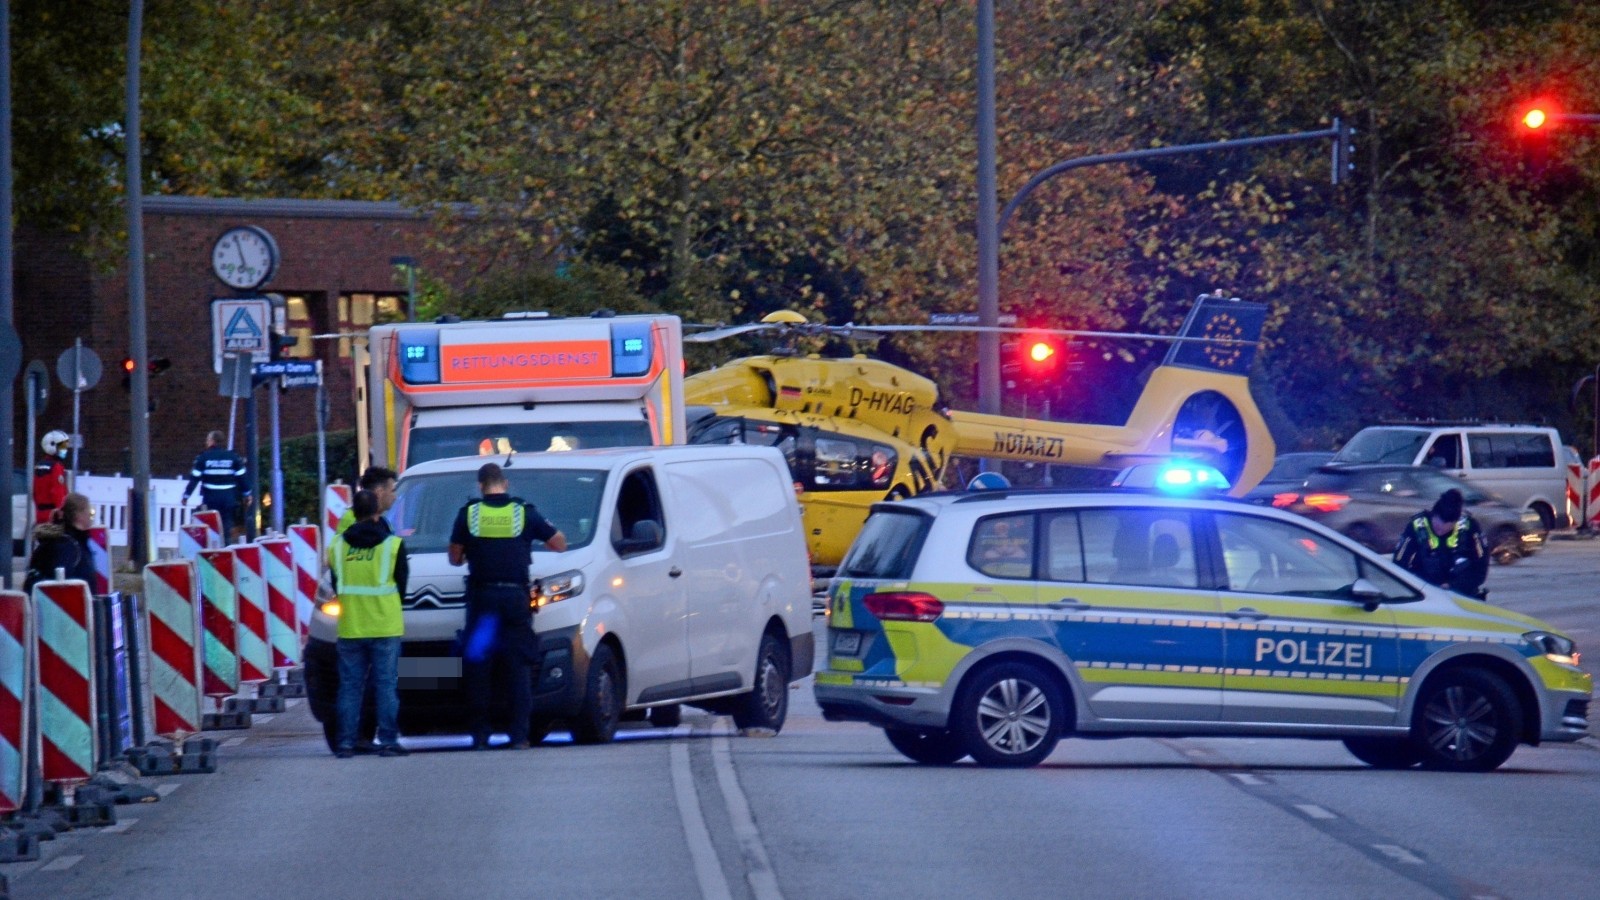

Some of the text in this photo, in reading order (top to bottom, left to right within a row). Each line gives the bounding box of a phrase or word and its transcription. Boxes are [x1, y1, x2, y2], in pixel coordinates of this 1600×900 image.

[226, 339, 259, 348] ALDI
[452, 352, 599, 369] RETTUNGSDIENST
[850, 387, 916, 415] D-HYAG
[993, 432, 1065, 458] NOTARZT
[205, 460, 233, 468] POLIZEI
[481, 516, 512, 526] POLIZEI
[1255, 638, 1372, 669] POLIZEI
